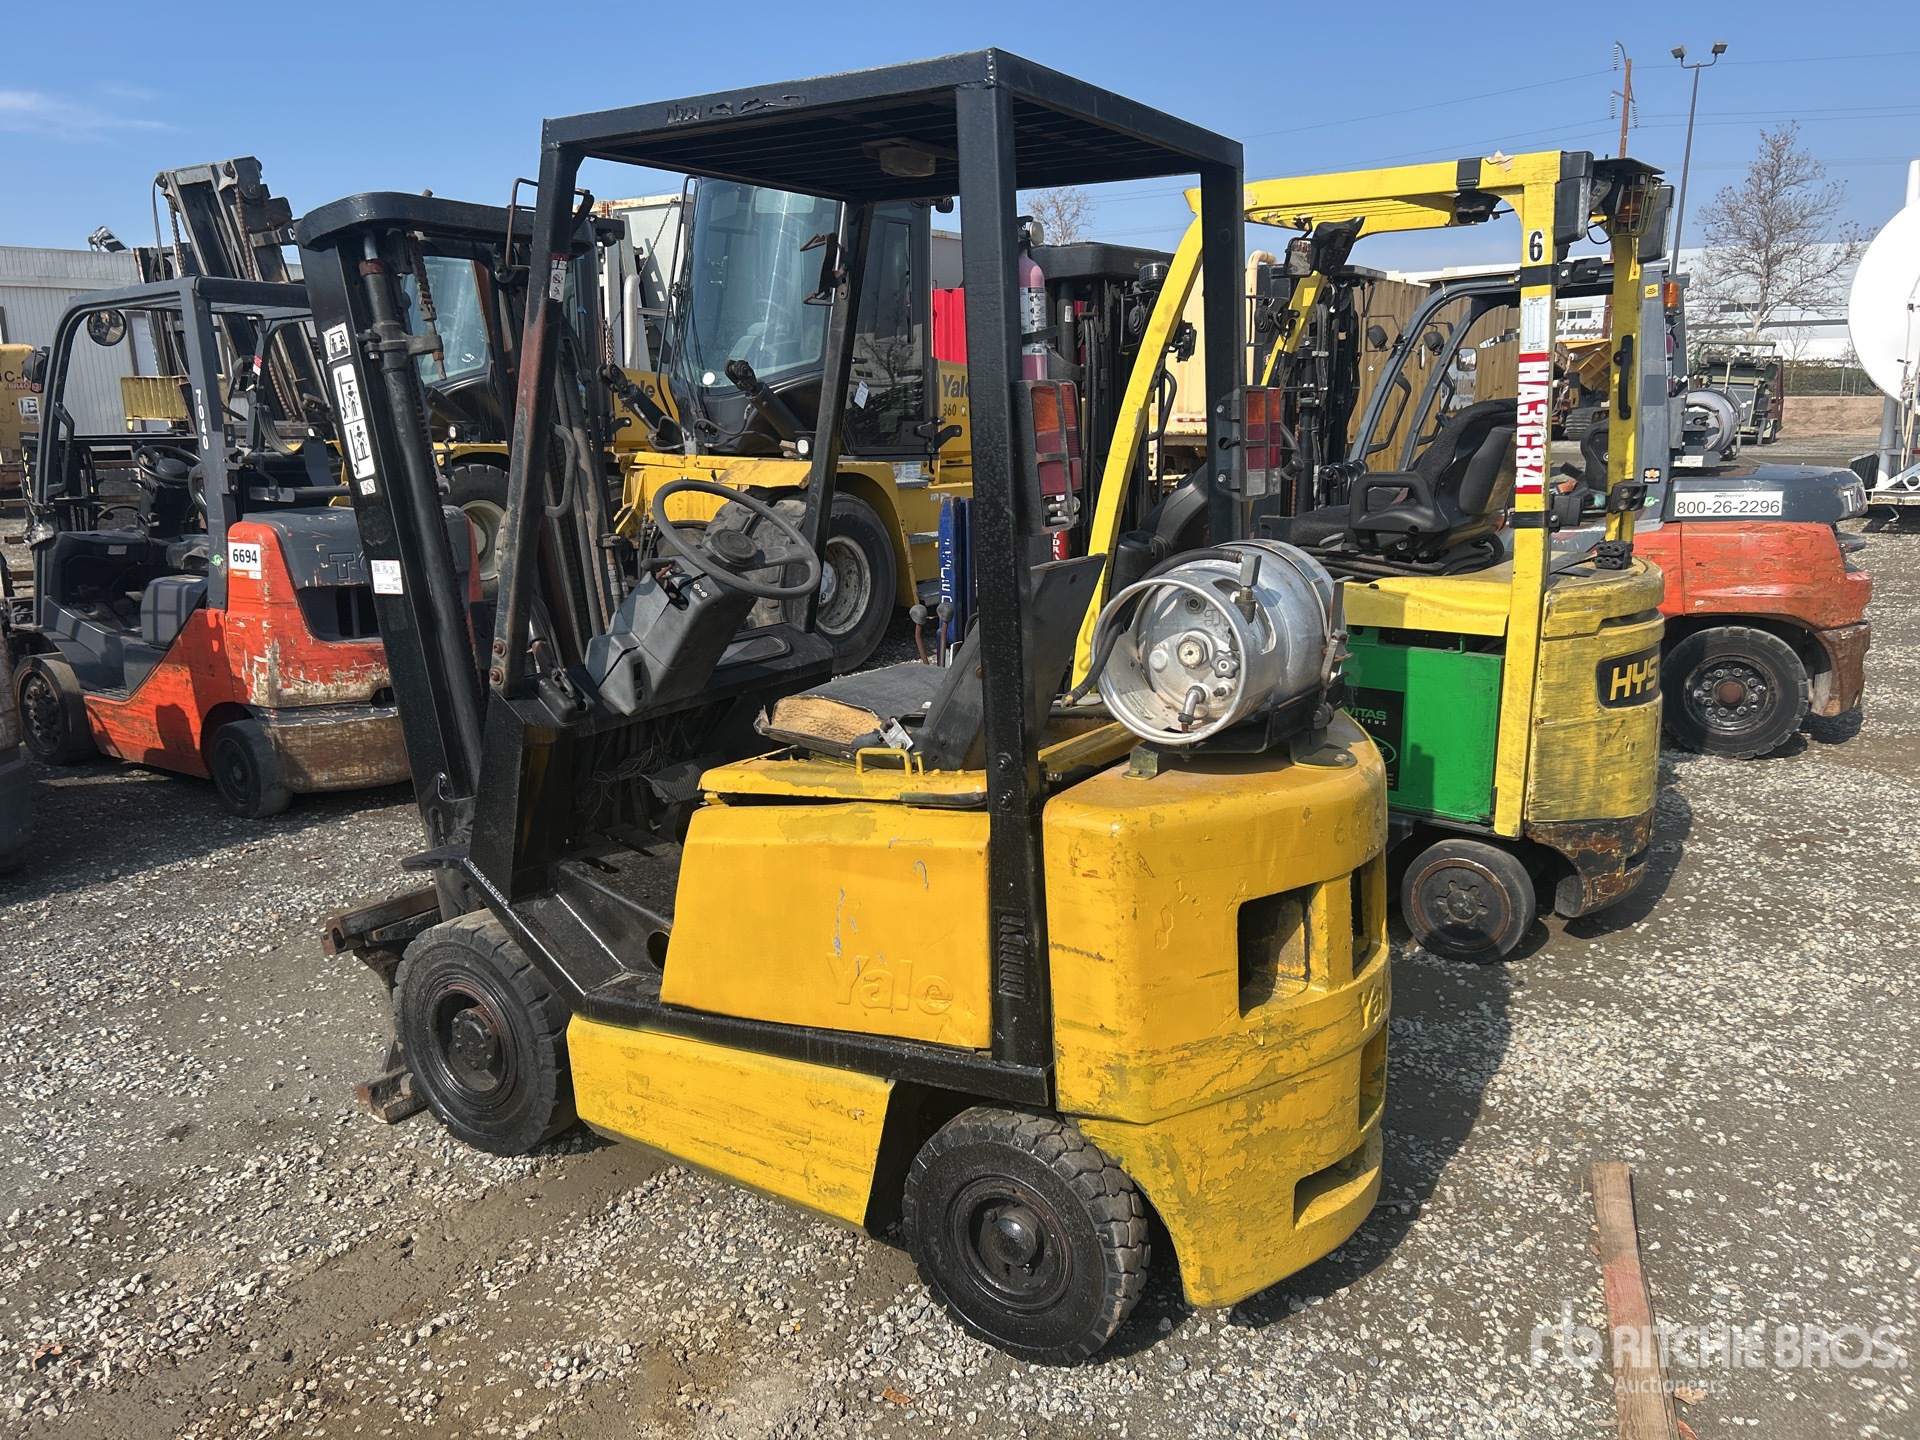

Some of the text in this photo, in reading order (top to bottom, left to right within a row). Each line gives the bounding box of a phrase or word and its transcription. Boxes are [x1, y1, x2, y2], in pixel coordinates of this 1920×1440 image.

[1529, 230, 1543, 262] 6
[195, 388, 209, 450] 7040
[942, 403, 957, 416] 360
[1516, 361, 1549, 488] HA3C84
[1677, 500, 1780, 514] 800-26-2296
[232, 548, 258, 564] 6694
[825, 952, 954, 1015] Yale
